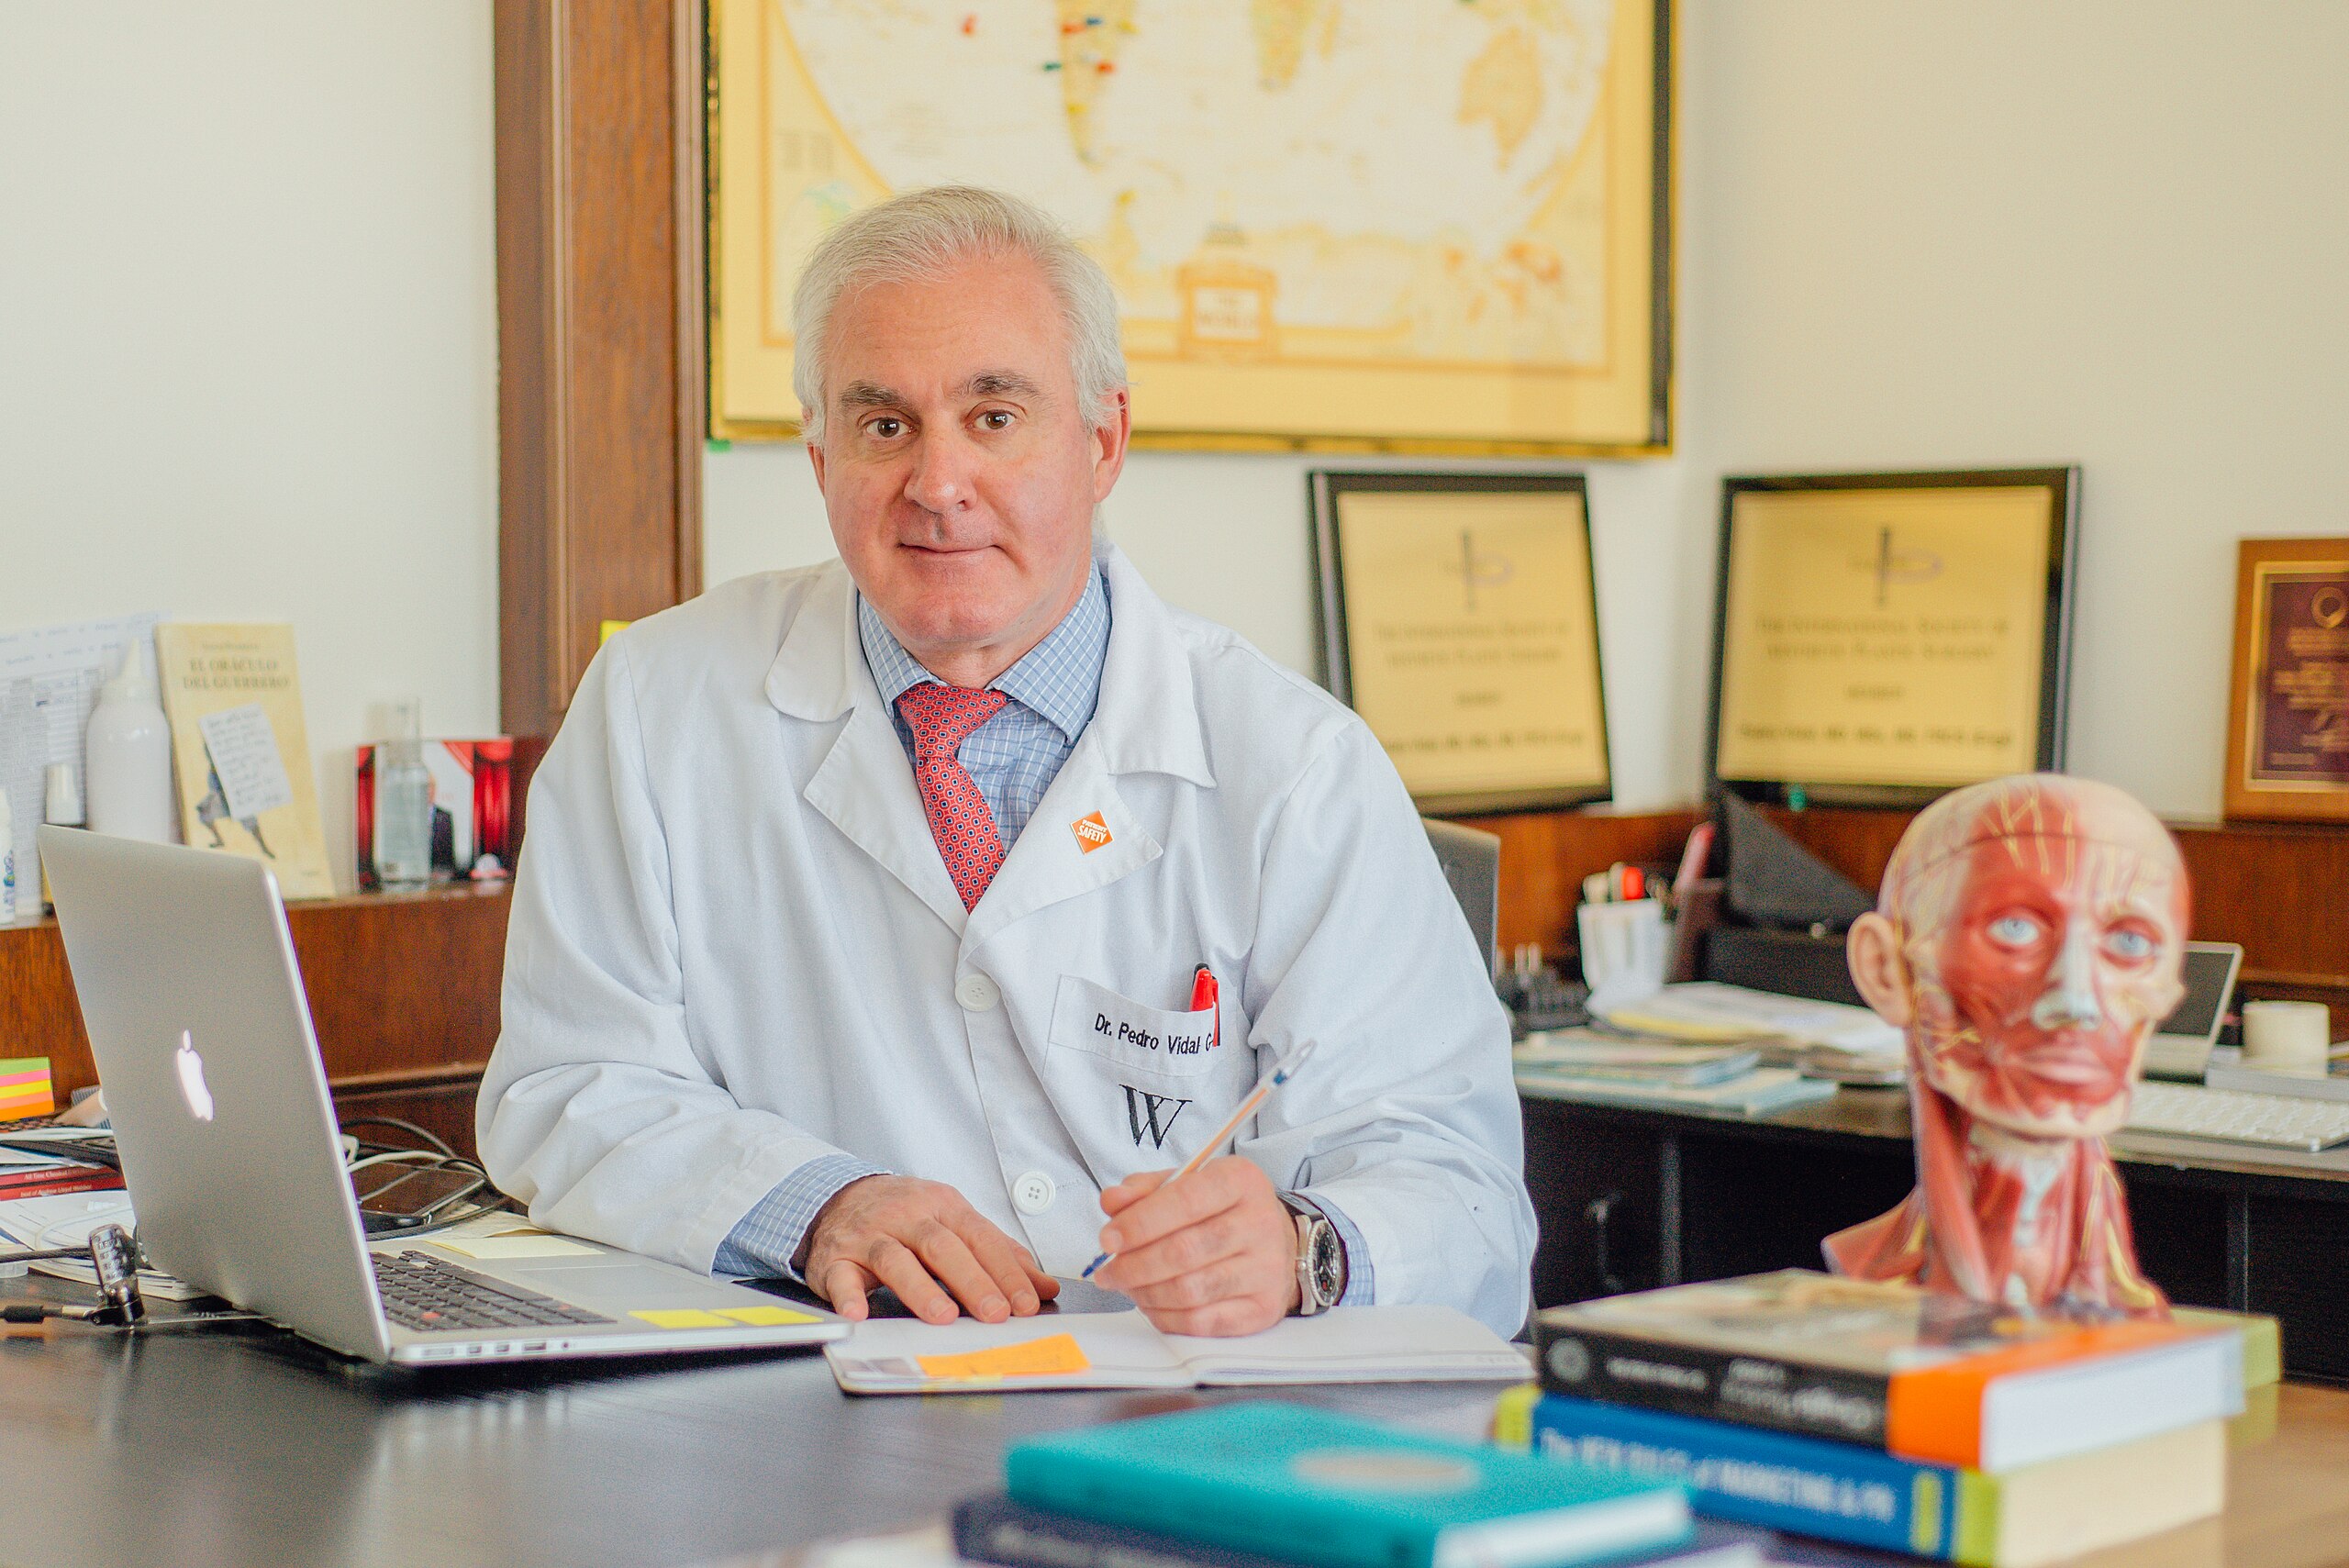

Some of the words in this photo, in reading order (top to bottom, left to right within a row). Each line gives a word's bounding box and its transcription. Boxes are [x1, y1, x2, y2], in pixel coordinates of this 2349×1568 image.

[1077, 825, 1107, 843] SAFETY
[1095, 1013, 1112, 1036] Dr.
[1118, 1021, 1159, 1050] Pedro
[1168, 1035, 1201, 1054] Vidal
[1119, 1084, 1193, 1150] W
